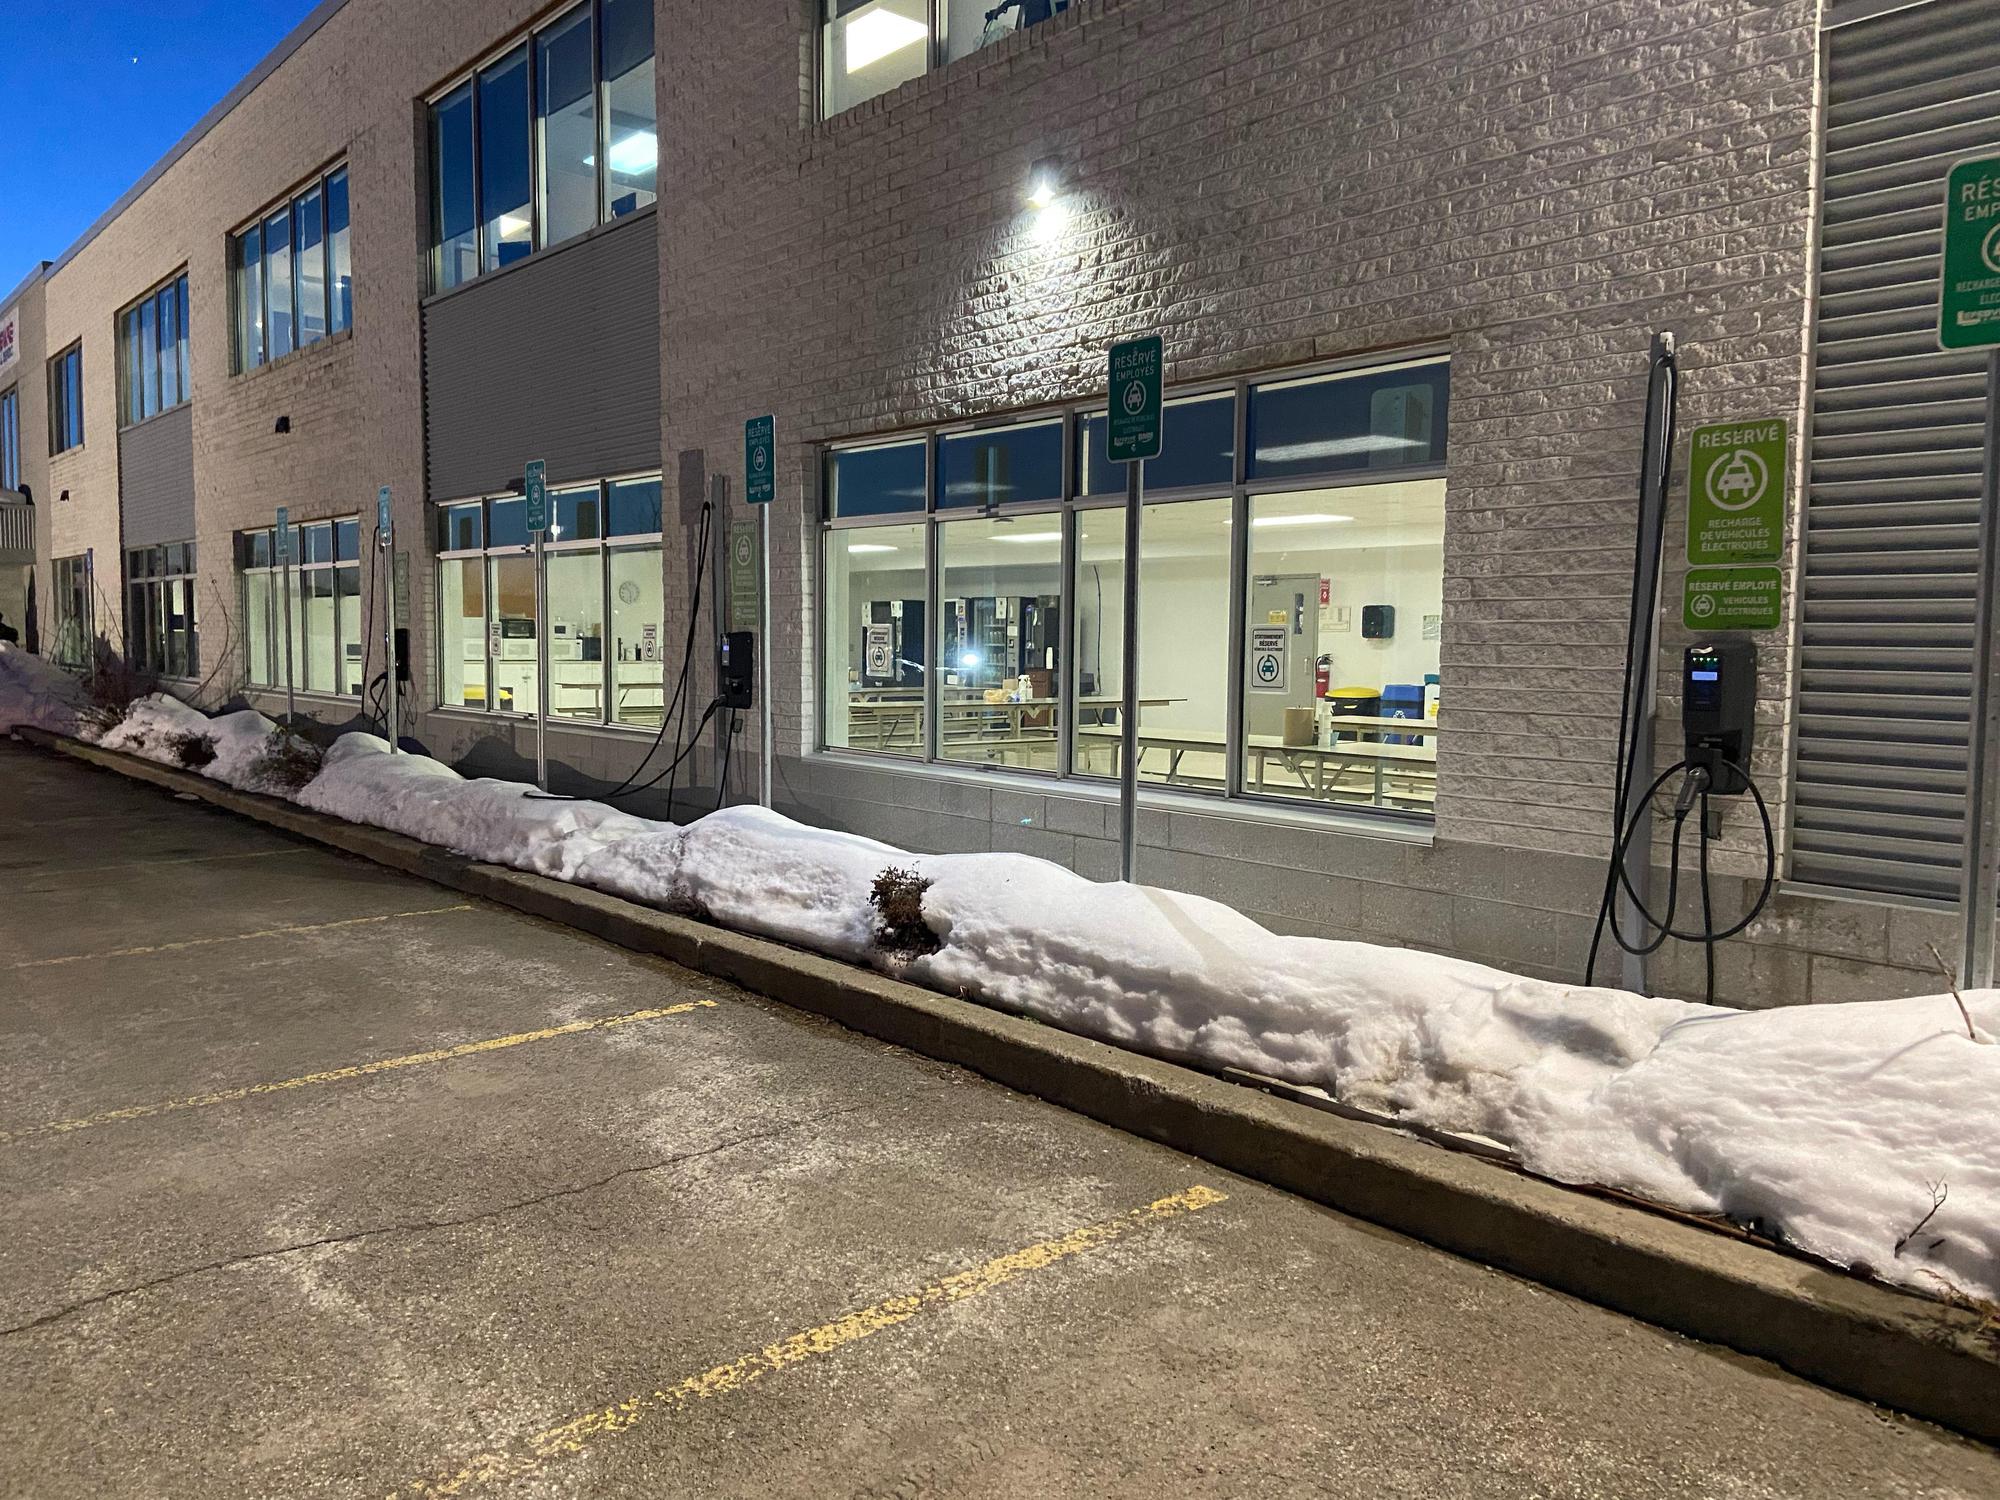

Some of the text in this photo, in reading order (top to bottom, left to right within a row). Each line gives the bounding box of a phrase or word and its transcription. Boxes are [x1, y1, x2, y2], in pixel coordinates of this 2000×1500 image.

[1114, 346, 1157, 370] RÉSERVÉ
[1700, 424, 1779, 448] RÉSERVÉ
[1708, 517, 1763, 528] RECHARGE
